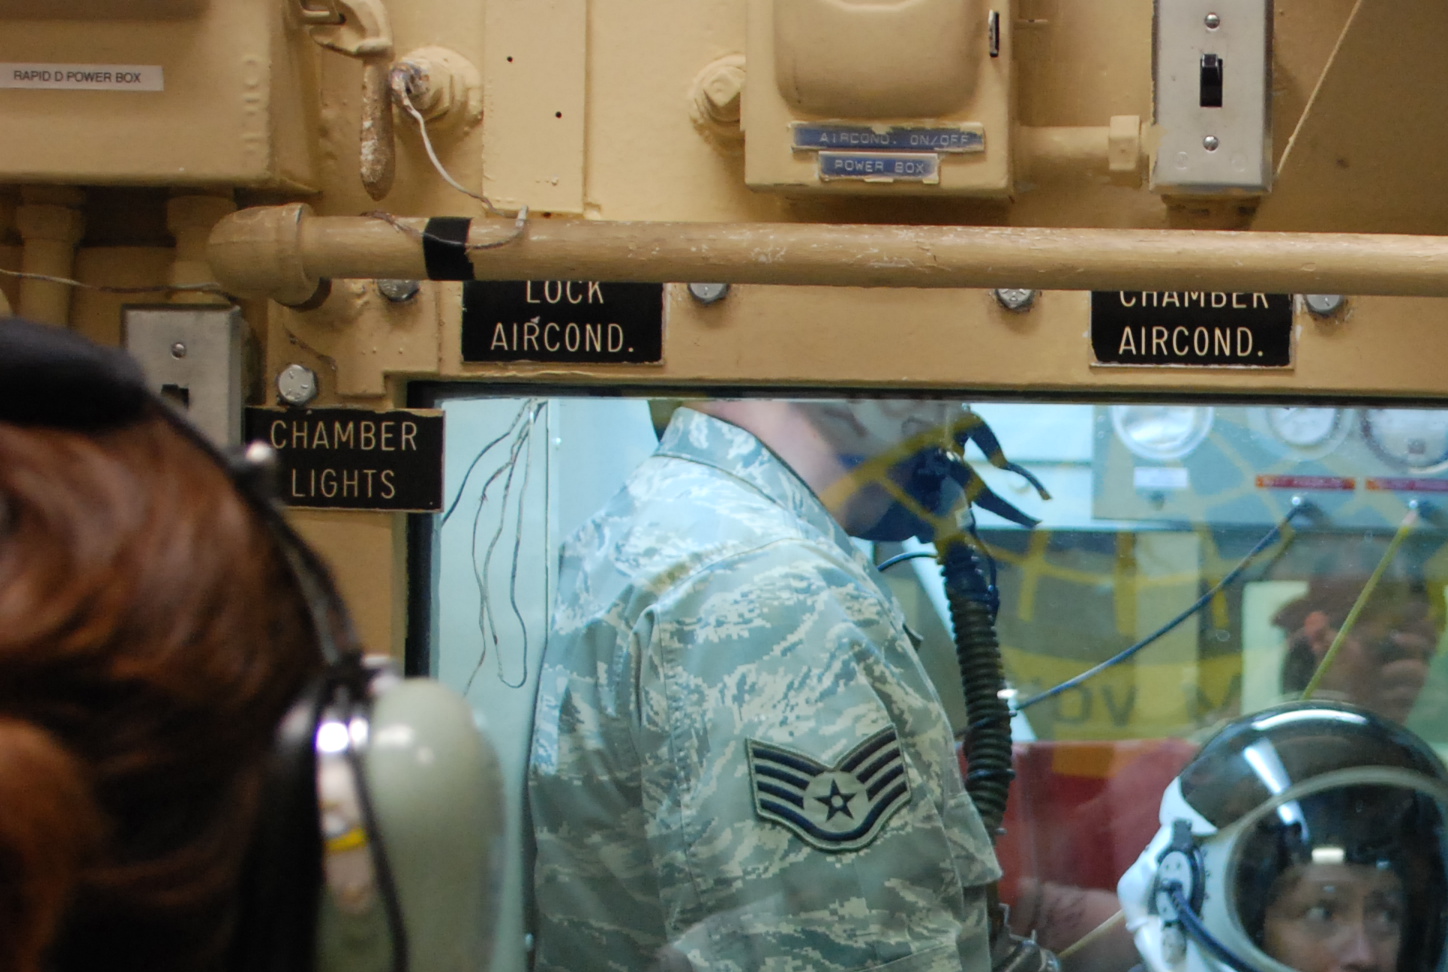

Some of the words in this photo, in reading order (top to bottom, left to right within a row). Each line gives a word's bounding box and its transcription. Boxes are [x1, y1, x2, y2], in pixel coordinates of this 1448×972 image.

[13, 70, 51, 82] RAPID
[54, 71, 63, 82] D
[67, 71, 112, 83] POWER
[116, 72, 141, 84] BOX
[819, 132, 897, 145] AIRCOND.
[910, 134, 969, 146] ON/OFF
[834, 159, 884, 172] POWER
[894, 161, 925, 174] BOX
[525, 281, 605, 304] LOCK
[1119, 291, 1269, 309] CHAMBER
[490, 322, 635, 353] AIRCOND.
[1118, 325, 1264, 357] AIRCOND.
[270, 420, 418, 452] CHAMBER
[290, 468, 396, 500] LIGHTS
